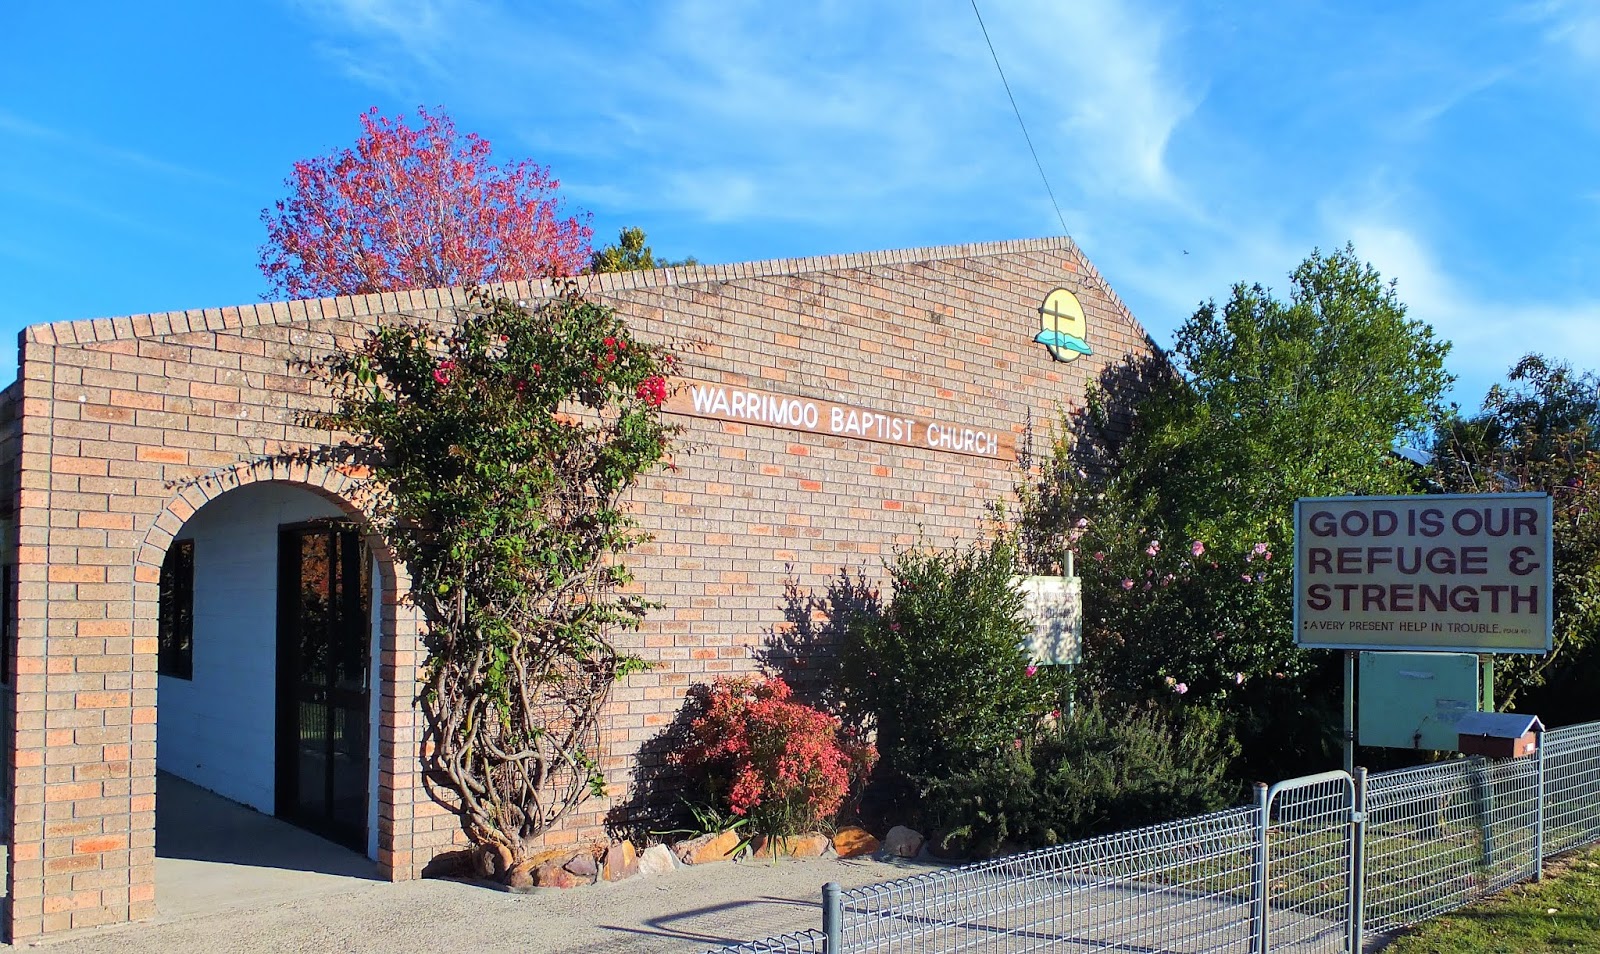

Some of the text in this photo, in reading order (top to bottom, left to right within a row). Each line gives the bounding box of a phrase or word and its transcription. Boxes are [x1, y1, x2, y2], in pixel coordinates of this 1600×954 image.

[691, 385, 998, 455] WARRIMOO BAPTIST CHURCH
[1309, 507, 1539, 537] GOD IS OUR
[1308, 546, 1540, 575] REFUGE &
[1306, 583, 1538, 614] STRENGTH
[1319, 620, 1345, 630] VERY
[1349, 621, 1394, 631] PRESENT
[1399, 621, 1428, 632] HELP
[1431, 622, 1443, 632] IN
